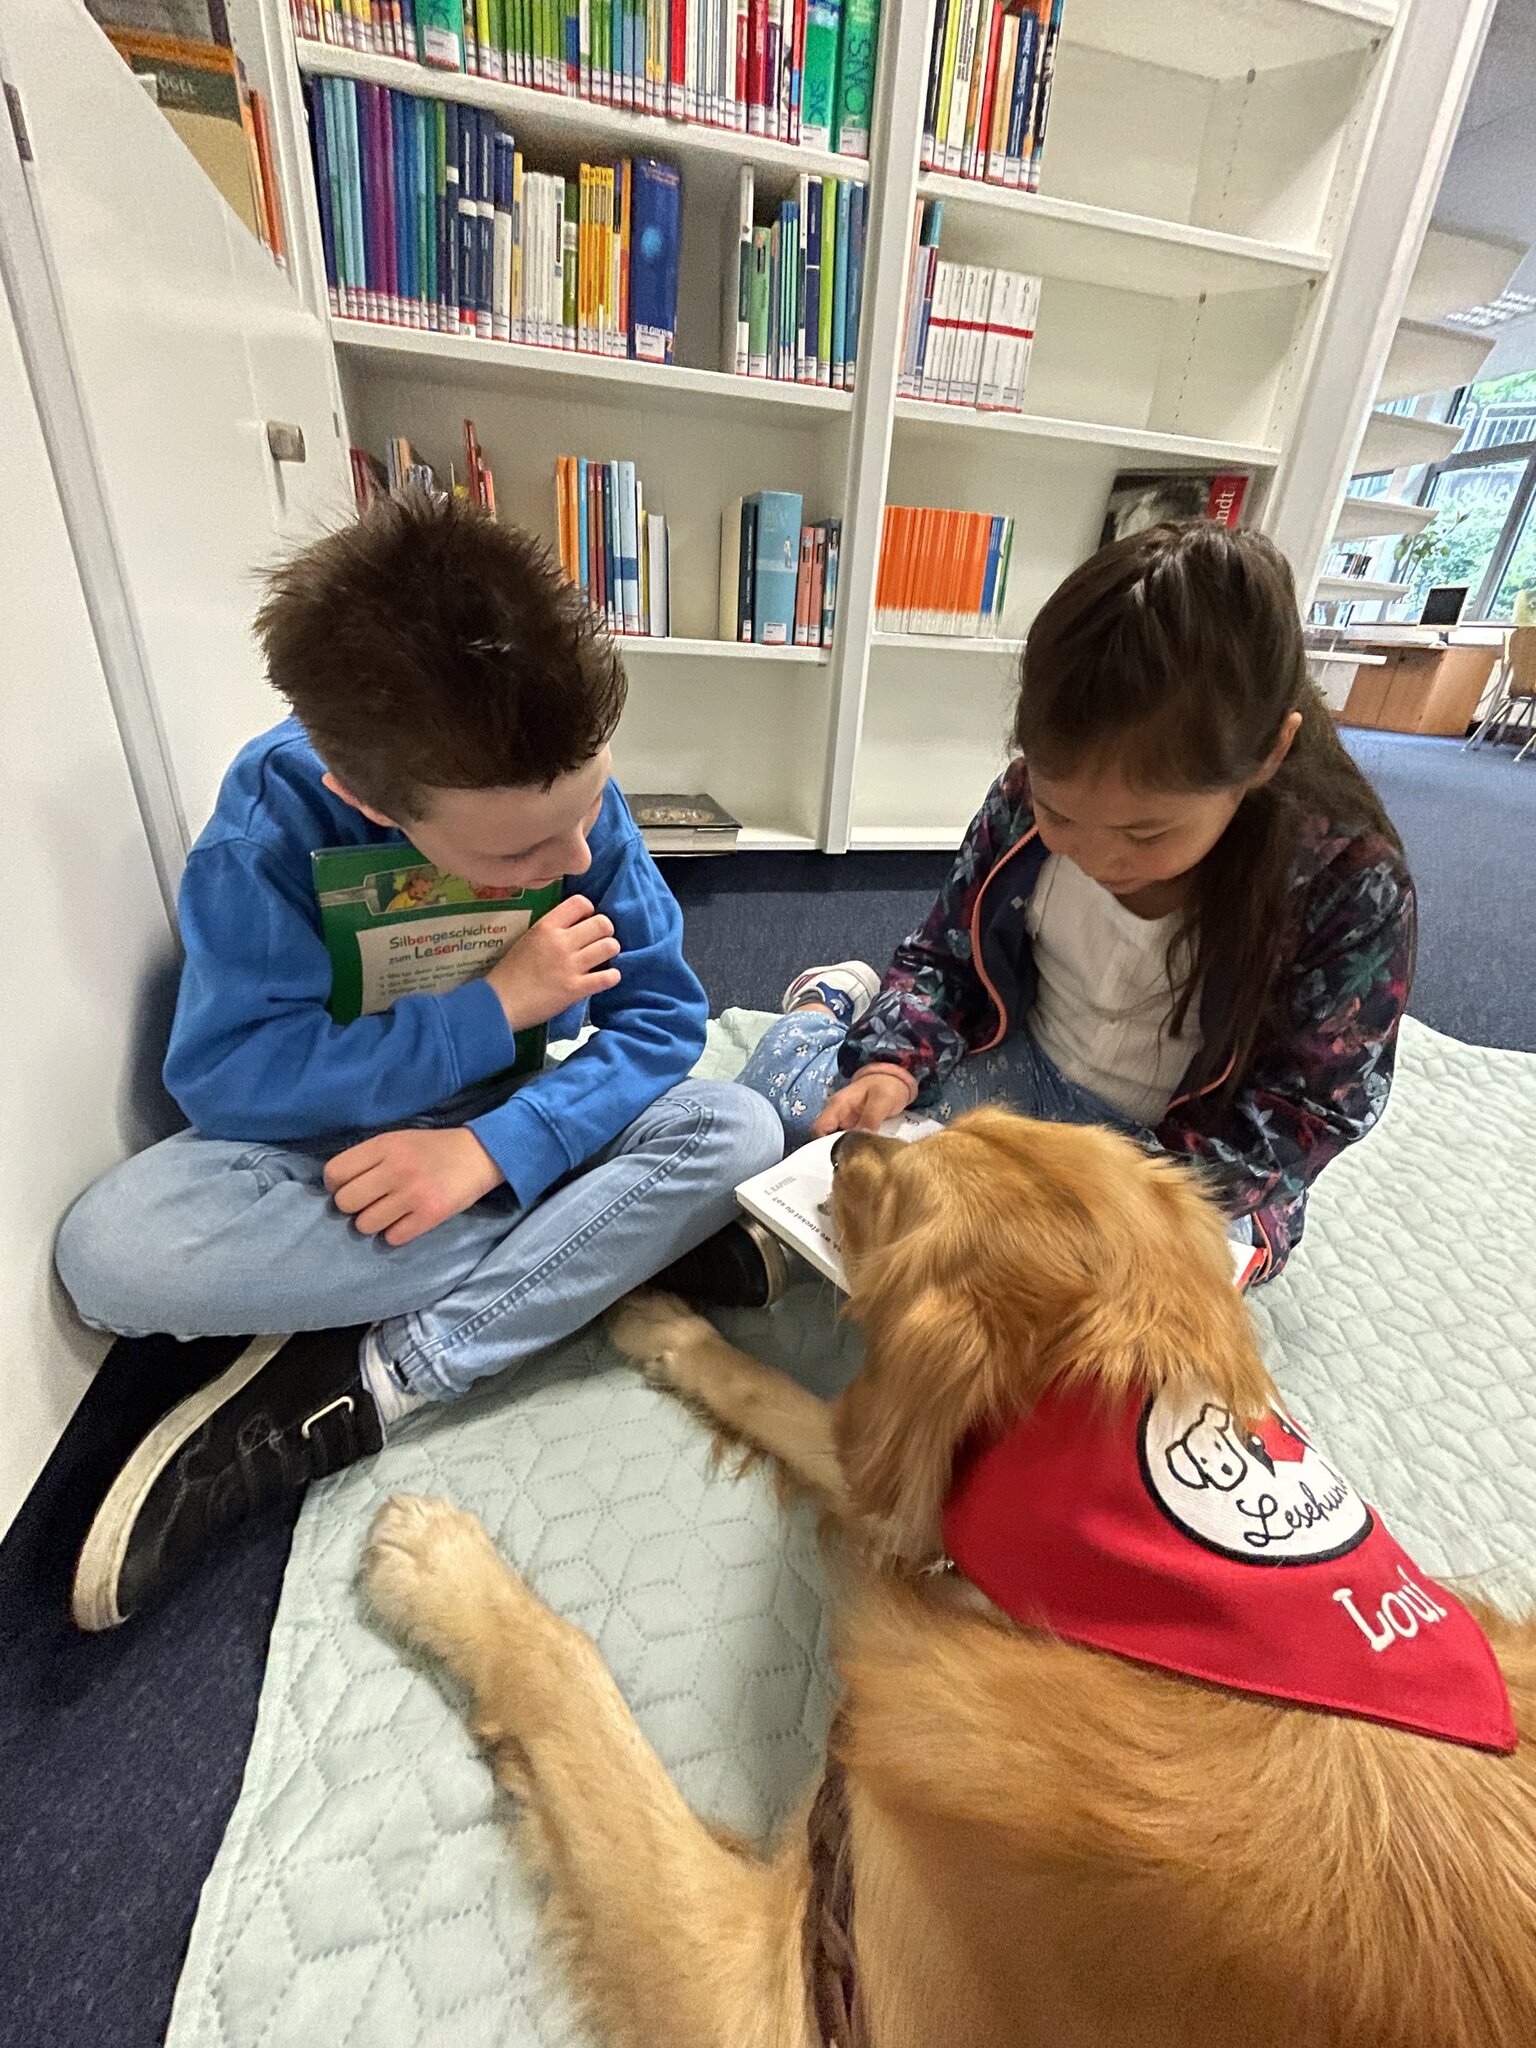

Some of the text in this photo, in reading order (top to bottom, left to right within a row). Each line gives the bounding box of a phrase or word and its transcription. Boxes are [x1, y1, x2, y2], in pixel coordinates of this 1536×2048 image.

[942, 269, 947, 282] 1
[956, 271, 963, 284] 2
[969, 272, 974, 285] 3
[982, 274, 989, 287] 4
[1023, 282, 1030, 294] 6
[1215, 490, 1236, 525] ndt
[389, 924, 508, 950] Silbengeschichten
[388, 938, 504, 965] zum Lesenlernen
[785, 1206, 795, 1214] du
[793, 1212, 820, 1233] steckst
